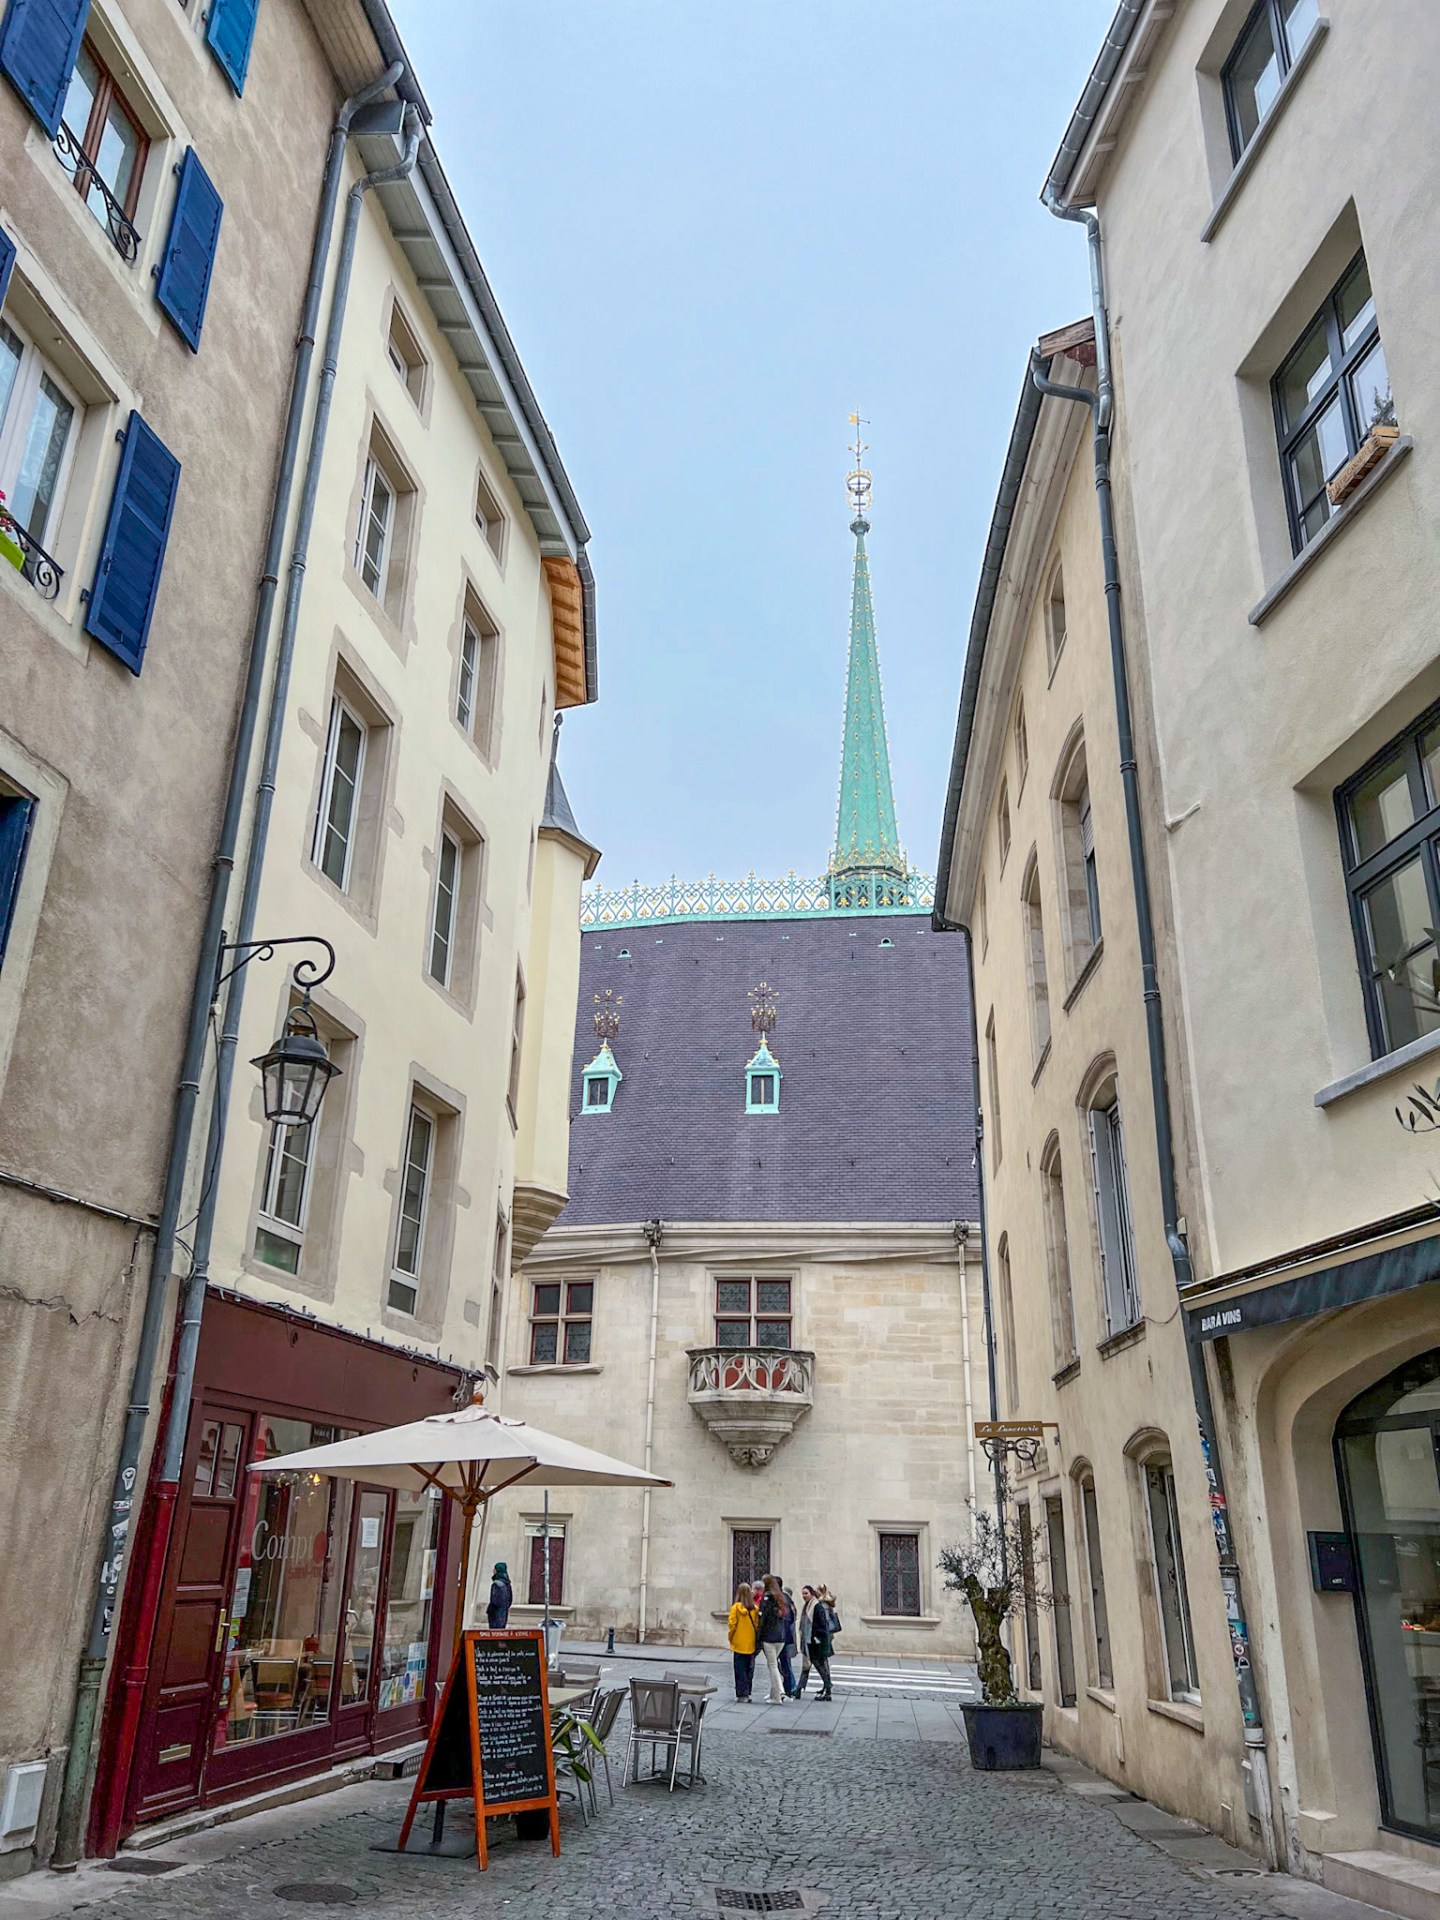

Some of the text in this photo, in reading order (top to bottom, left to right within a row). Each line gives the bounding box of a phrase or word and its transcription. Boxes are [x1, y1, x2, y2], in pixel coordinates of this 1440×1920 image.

[1202, 1309, 1241, 1331] BAR À VINS
